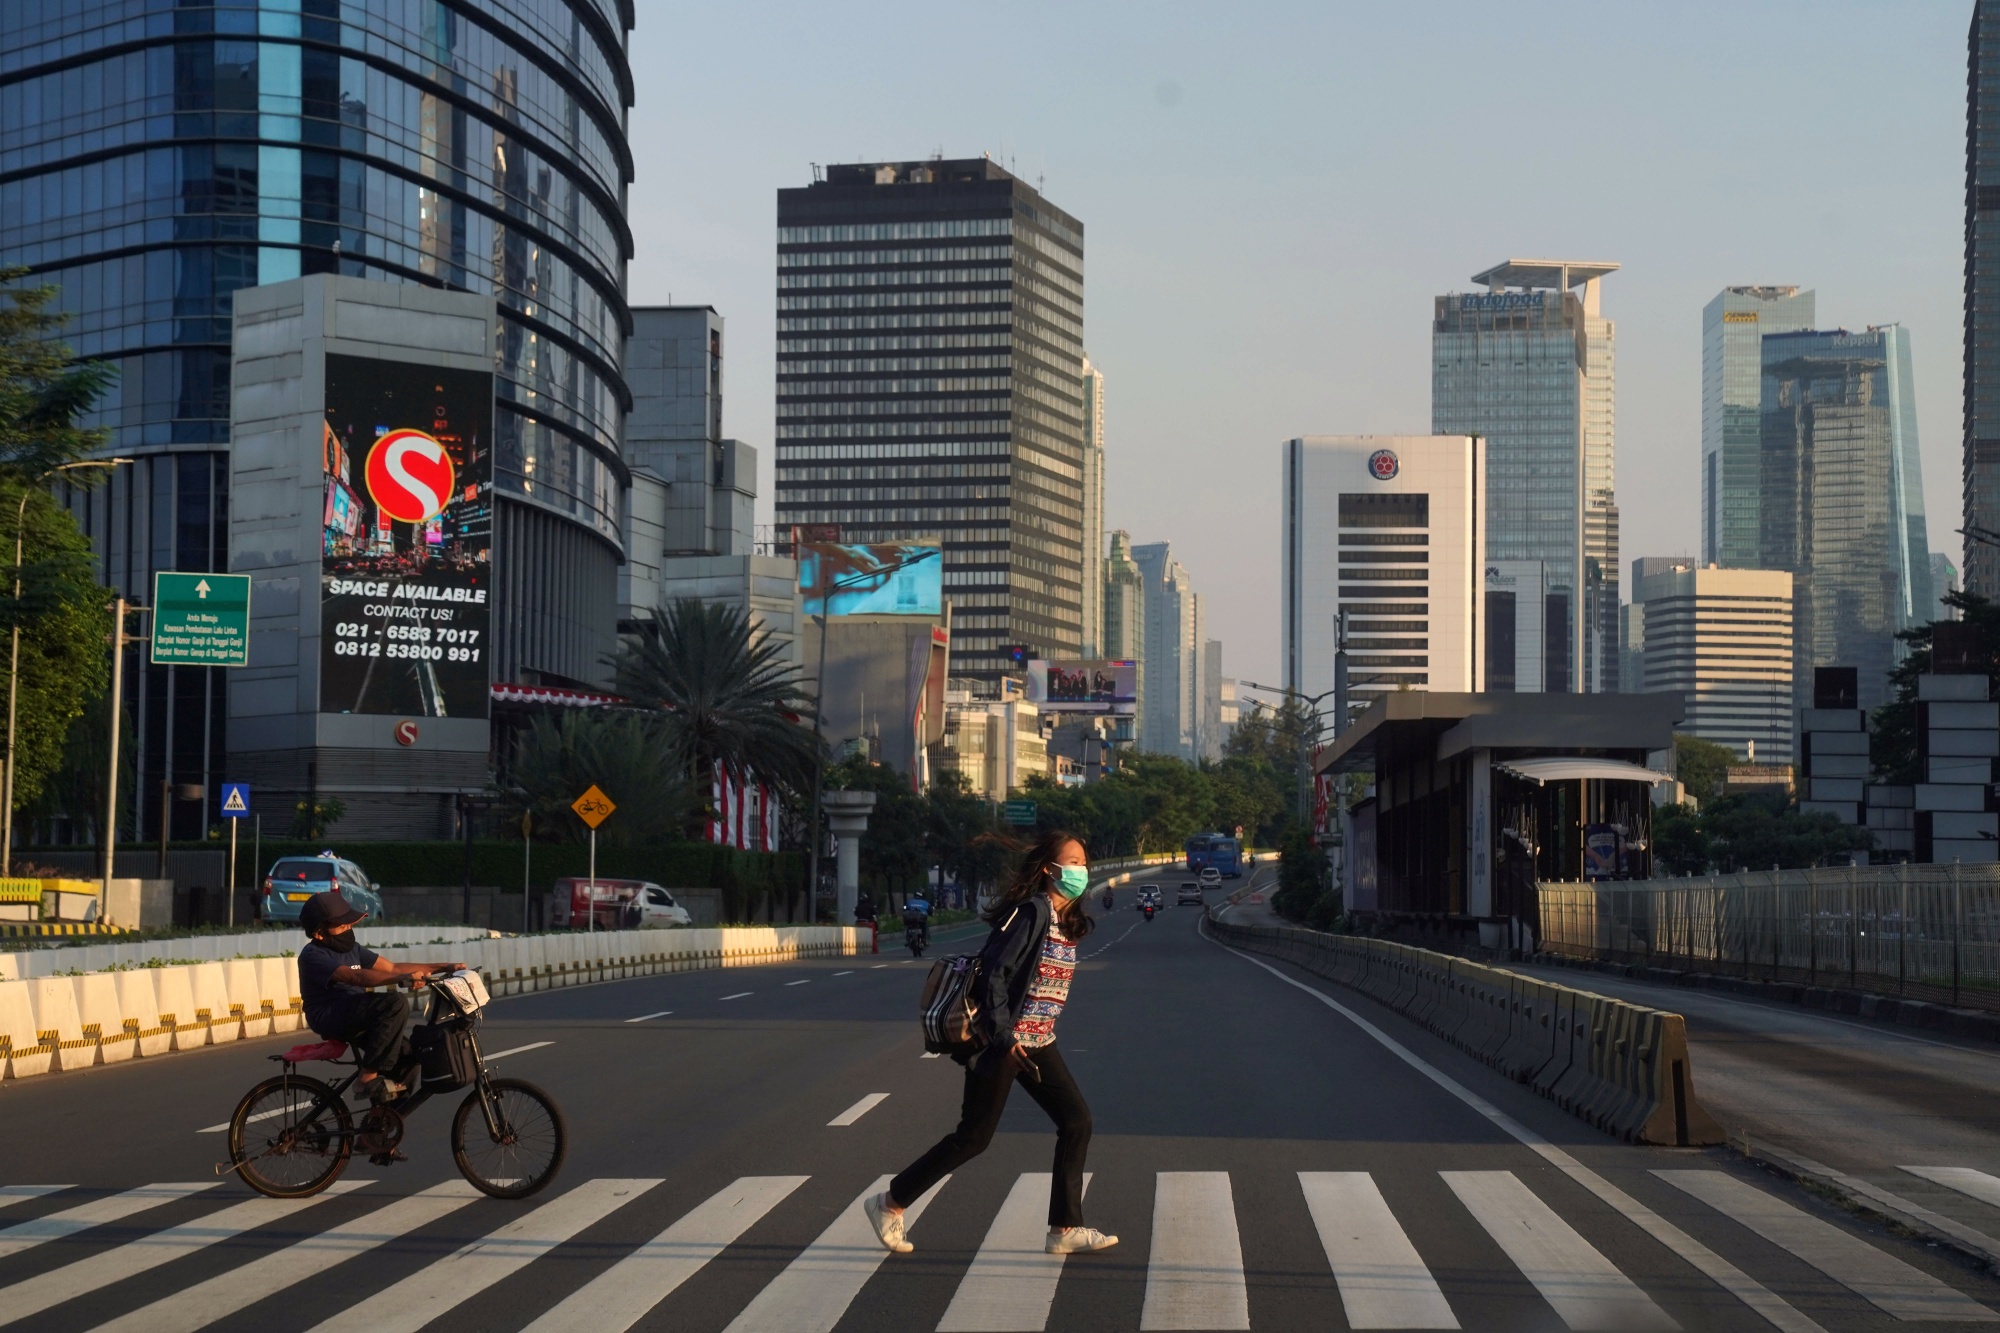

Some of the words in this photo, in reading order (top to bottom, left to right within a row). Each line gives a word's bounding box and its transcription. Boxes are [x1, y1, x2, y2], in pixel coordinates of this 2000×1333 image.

[1460, 290, 1545, 310] Indofood
[1831, 333, 1878, 347] Keppel
[385, 436, 443, 519] S
[329, 580, 389, 598] SPACE
[392, 584, 487, 603] AVAILABLE
[363, 604, 429, 619] CONTACT
[430, 608, 454, 621] US!
[165, 624, 184, 632] Kawasan
[214, 626, 223, 634] Lalu
[224, 626, 237, 634] Lintas
[335, 622, 369, 638] 021
[386, 625, 431, 641] 6583
[436, 628, 480, 644] 7017
[334, 641, 380, 657] 0812
[386, 643, 443, 660] 53800
[447, 647, 480, 663] 991
